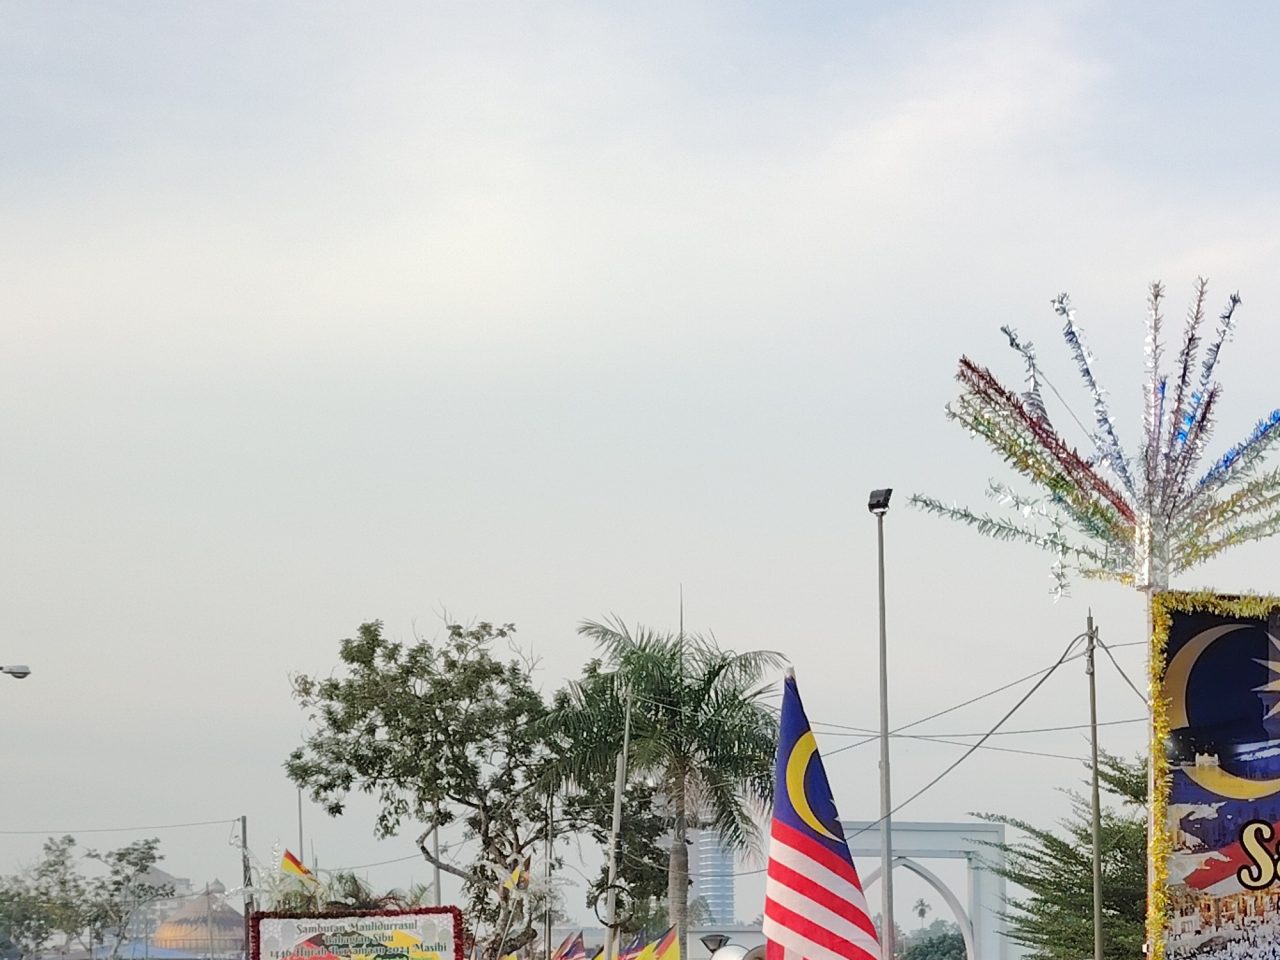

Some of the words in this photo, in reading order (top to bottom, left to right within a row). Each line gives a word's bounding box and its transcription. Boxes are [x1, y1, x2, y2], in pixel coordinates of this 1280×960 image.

[296, 923, 346, 934] Sambutan
[324, 935, 371, 945] Bahagian
[372, 933, 394, 943] Sibu
[386, 946, 410, 956] 2024
[413, 942, 447, 953] Masihi
